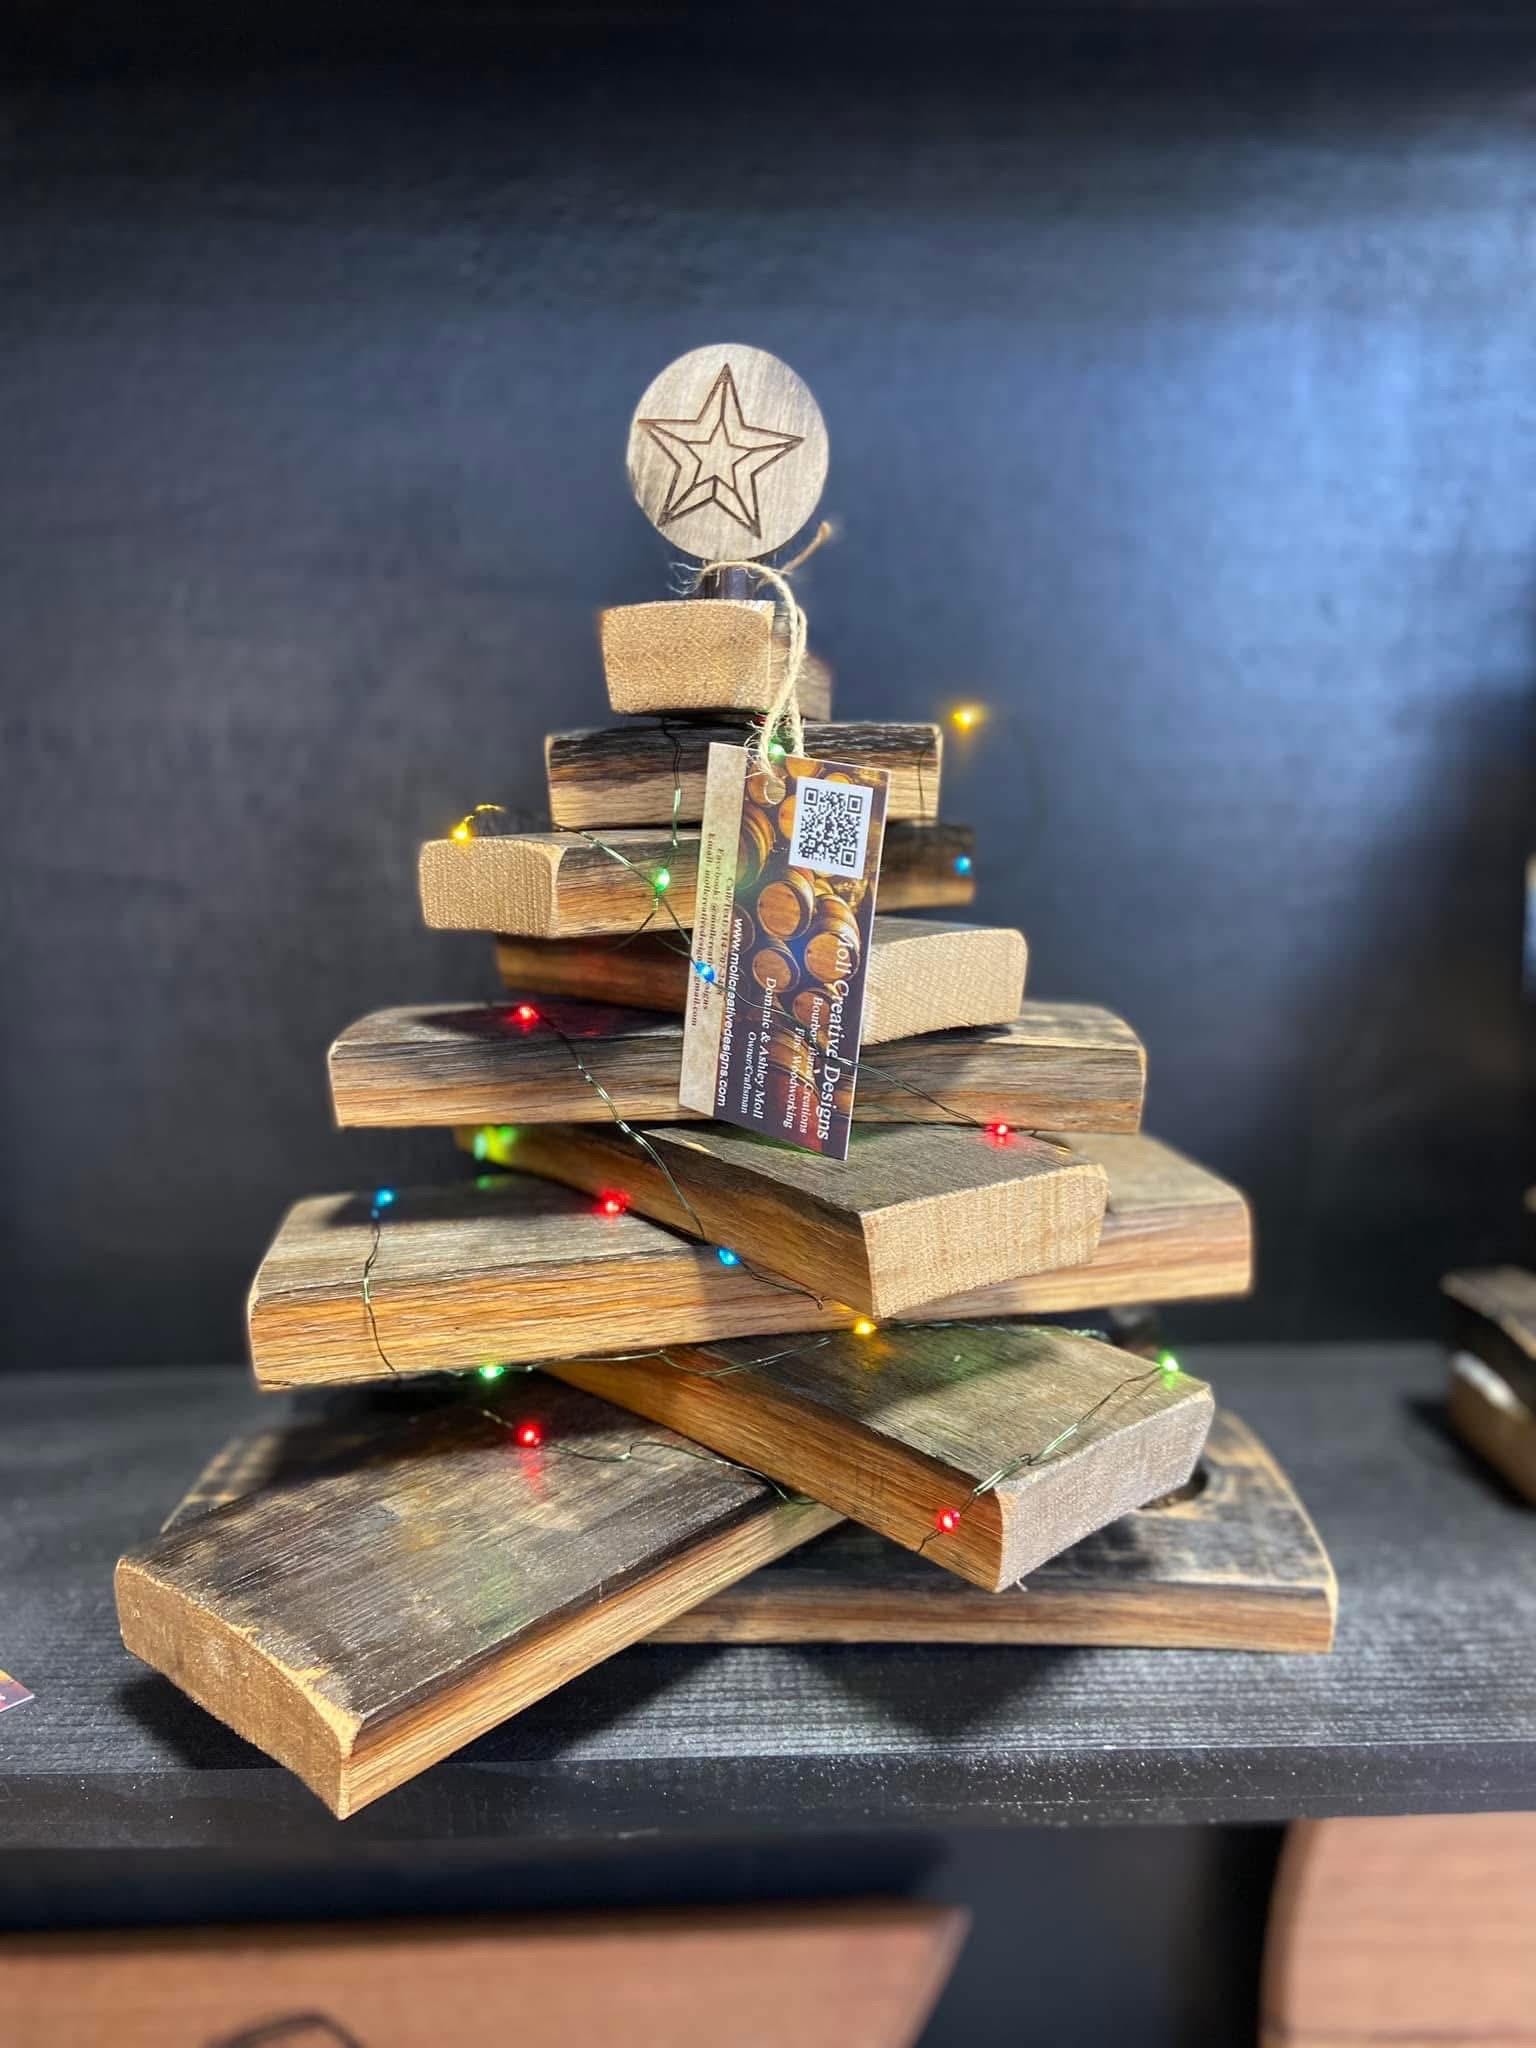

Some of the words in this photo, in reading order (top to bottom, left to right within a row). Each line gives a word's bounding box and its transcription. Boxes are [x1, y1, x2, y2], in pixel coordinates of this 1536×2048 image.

[835, 931, 854, 974] Moll
[717, 918, 743, 1107] www.mollcreativedesigns.com
[761, 977, 777, 1029] Dominic
[826, 979, 850, 1059] Creative
[760, 1031, 771, 1043] &
[792, 1027, 806, 1049] Fine
[740, 1031, 757, 1114] Owner/Craftsman
[754, 1045, 770, 1088] Ashley
[783, 1055, 802, 1129] Woodworking
[753, 1089, 766, 1119] Moll
[800, 1082, 814, 1134] Creations
[816, 1063, 841, 1140] Designs
